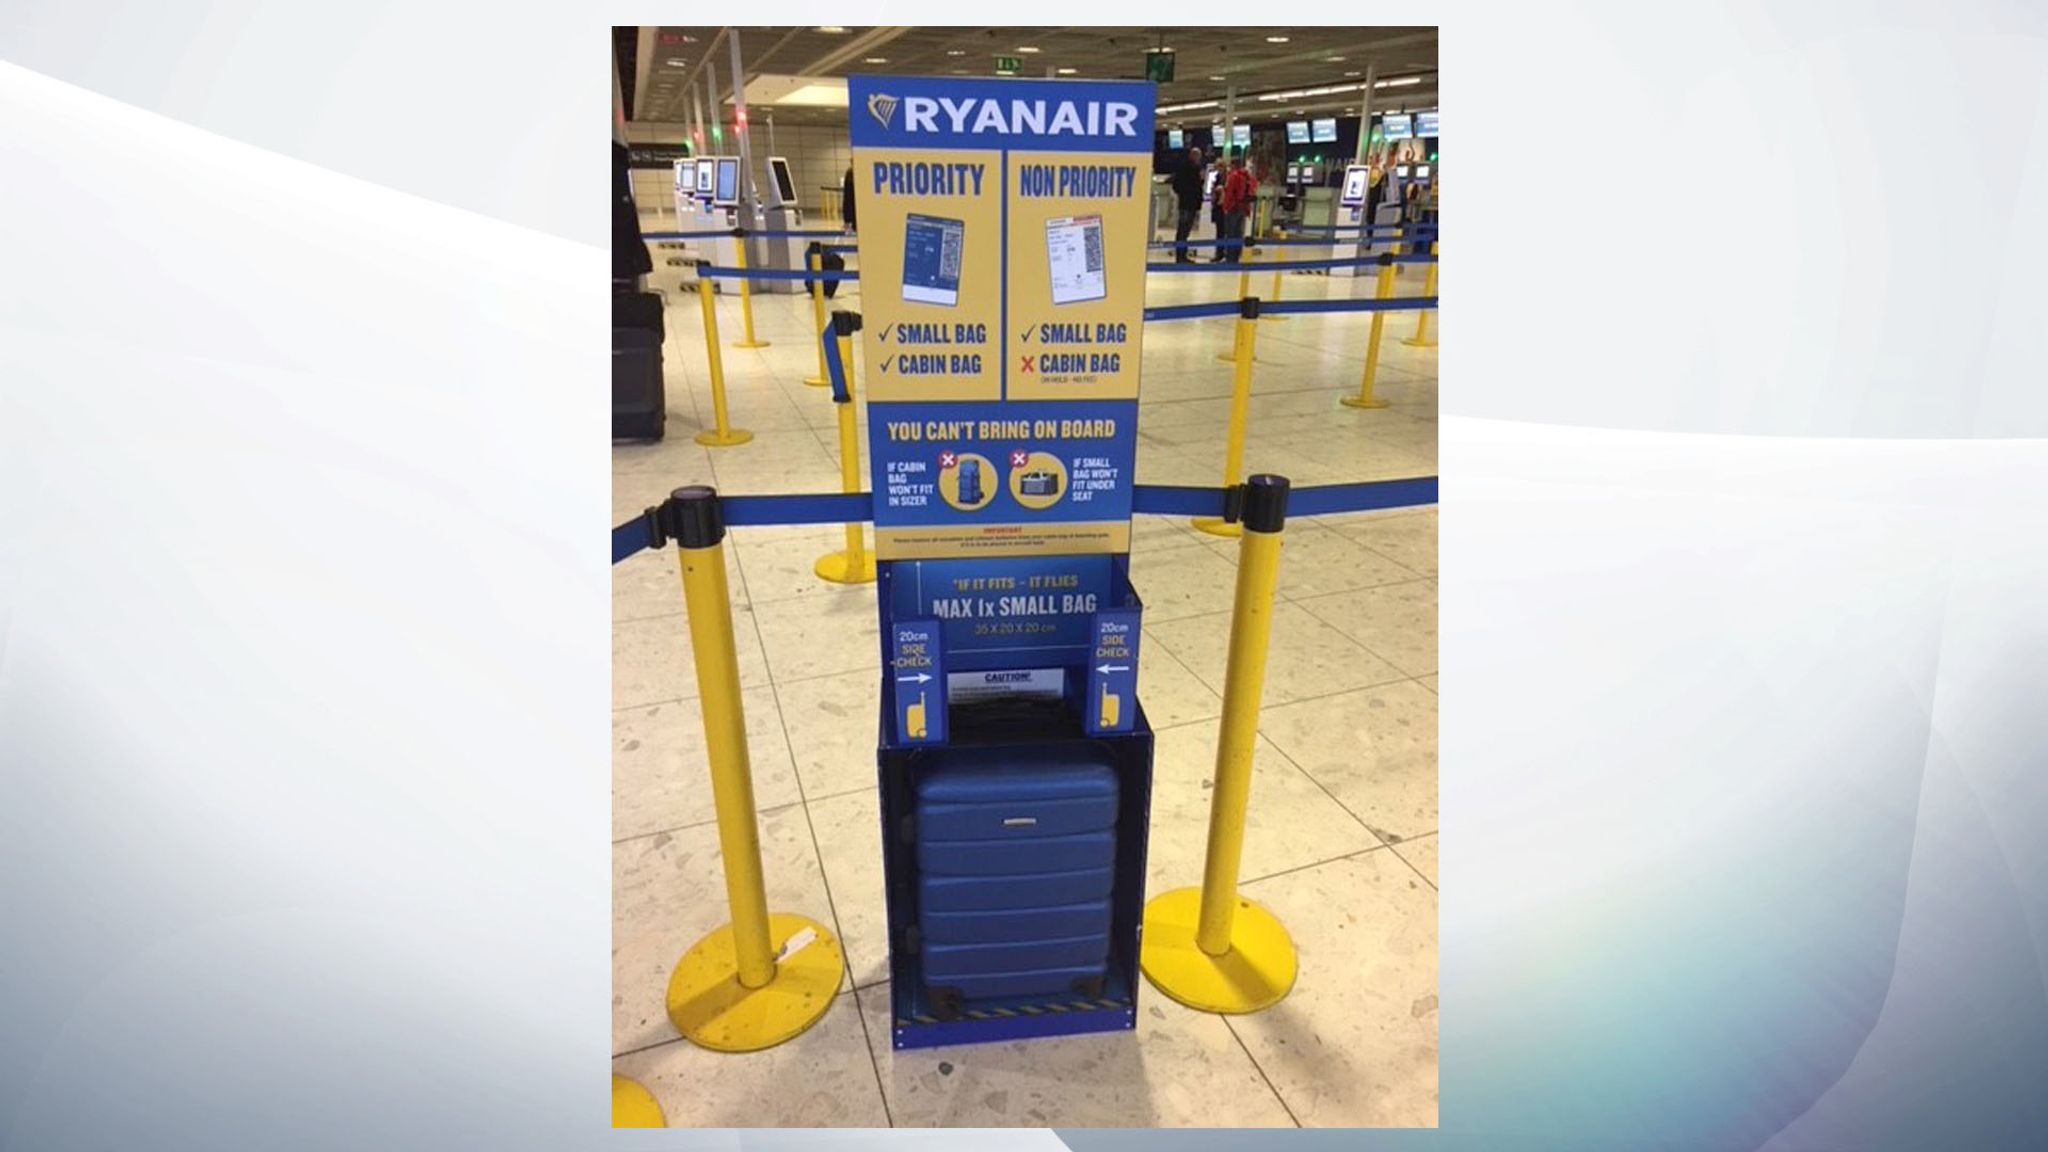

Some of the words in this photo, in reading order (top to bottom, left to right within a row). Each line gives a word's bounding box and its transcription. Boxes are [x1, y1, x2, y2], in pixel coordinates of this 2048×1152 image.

[904, 96, 1139, 136] RYANAIR
[873, 162, 985, 196] PRIORITY
[1020, 165, 1055, 197] NON
[1059, 166, 1136, 198] PRIORITY
[897, 323, 951, 344] SMALL
[955, 323, 987, 344] BAG
[1040, 323, 1093, 344] SMALL
[1096, 323, 1127, 344] BAG
[898, 354, 946, 374] CABIN
[951, 354, 982, 374] BAG
[1040, 353, 1086, 373] CABIN
[1091, 353, 1121, 373] BAG
[887, 422, 922, 441] YOU
[926, 421, 974, 440] CAN'T
[979, 420, 1030, 440] BRING
[1034, 420, 1056, 439] ON
[1060, 419, 1116, 438] BOARD
[887, 462, 896, 473] IF
[898, 462, 926, 473] CABIN
[1073, 458, 1081, 468] IF
[1082, 457, 1111, 468] SMALL
[888, 474, 907, 484] BAG
[1073, 469, 1091, 479] BAG
[1092, 468, 1118, 479] WON'T
[888, 485, 918, 496] WON'T
[919, 484, 934, 495] FIT
[1073, 480, 1086, 490] FIT
[1087, 479, 1116, 490] UNDER
[889, 496, 899, 506] IN
[900, 495, 928, 506] SIZER
[1073, 491, 1093, 501] SEAT
[973, 579, 985, 590] IT
[988, 577, 1016, 590] FITS
[1029, 576, 1042, 589] IT
[1043, 575, 1079, 588] FLIES
[932, 598, 973, 619] MAX
[999, 595, 1058, 617] SMALL
[1062, 594, 1097, 614] BAG
[1000, 623, 1015, 634] 20
[1025, 622, 1040, 633] 20
[1041, 624, 1057, 633] cm
[1101, 622, 1129, 633] 20cm
[899, 632, 929, 642] 20cm
[1102, 635, 1126, 645] SIDE
[902, 644, 926, 655] SIDE
[1096, 647, 1129, 658] CHECK
[896, 656, 932, 667] CHECK
